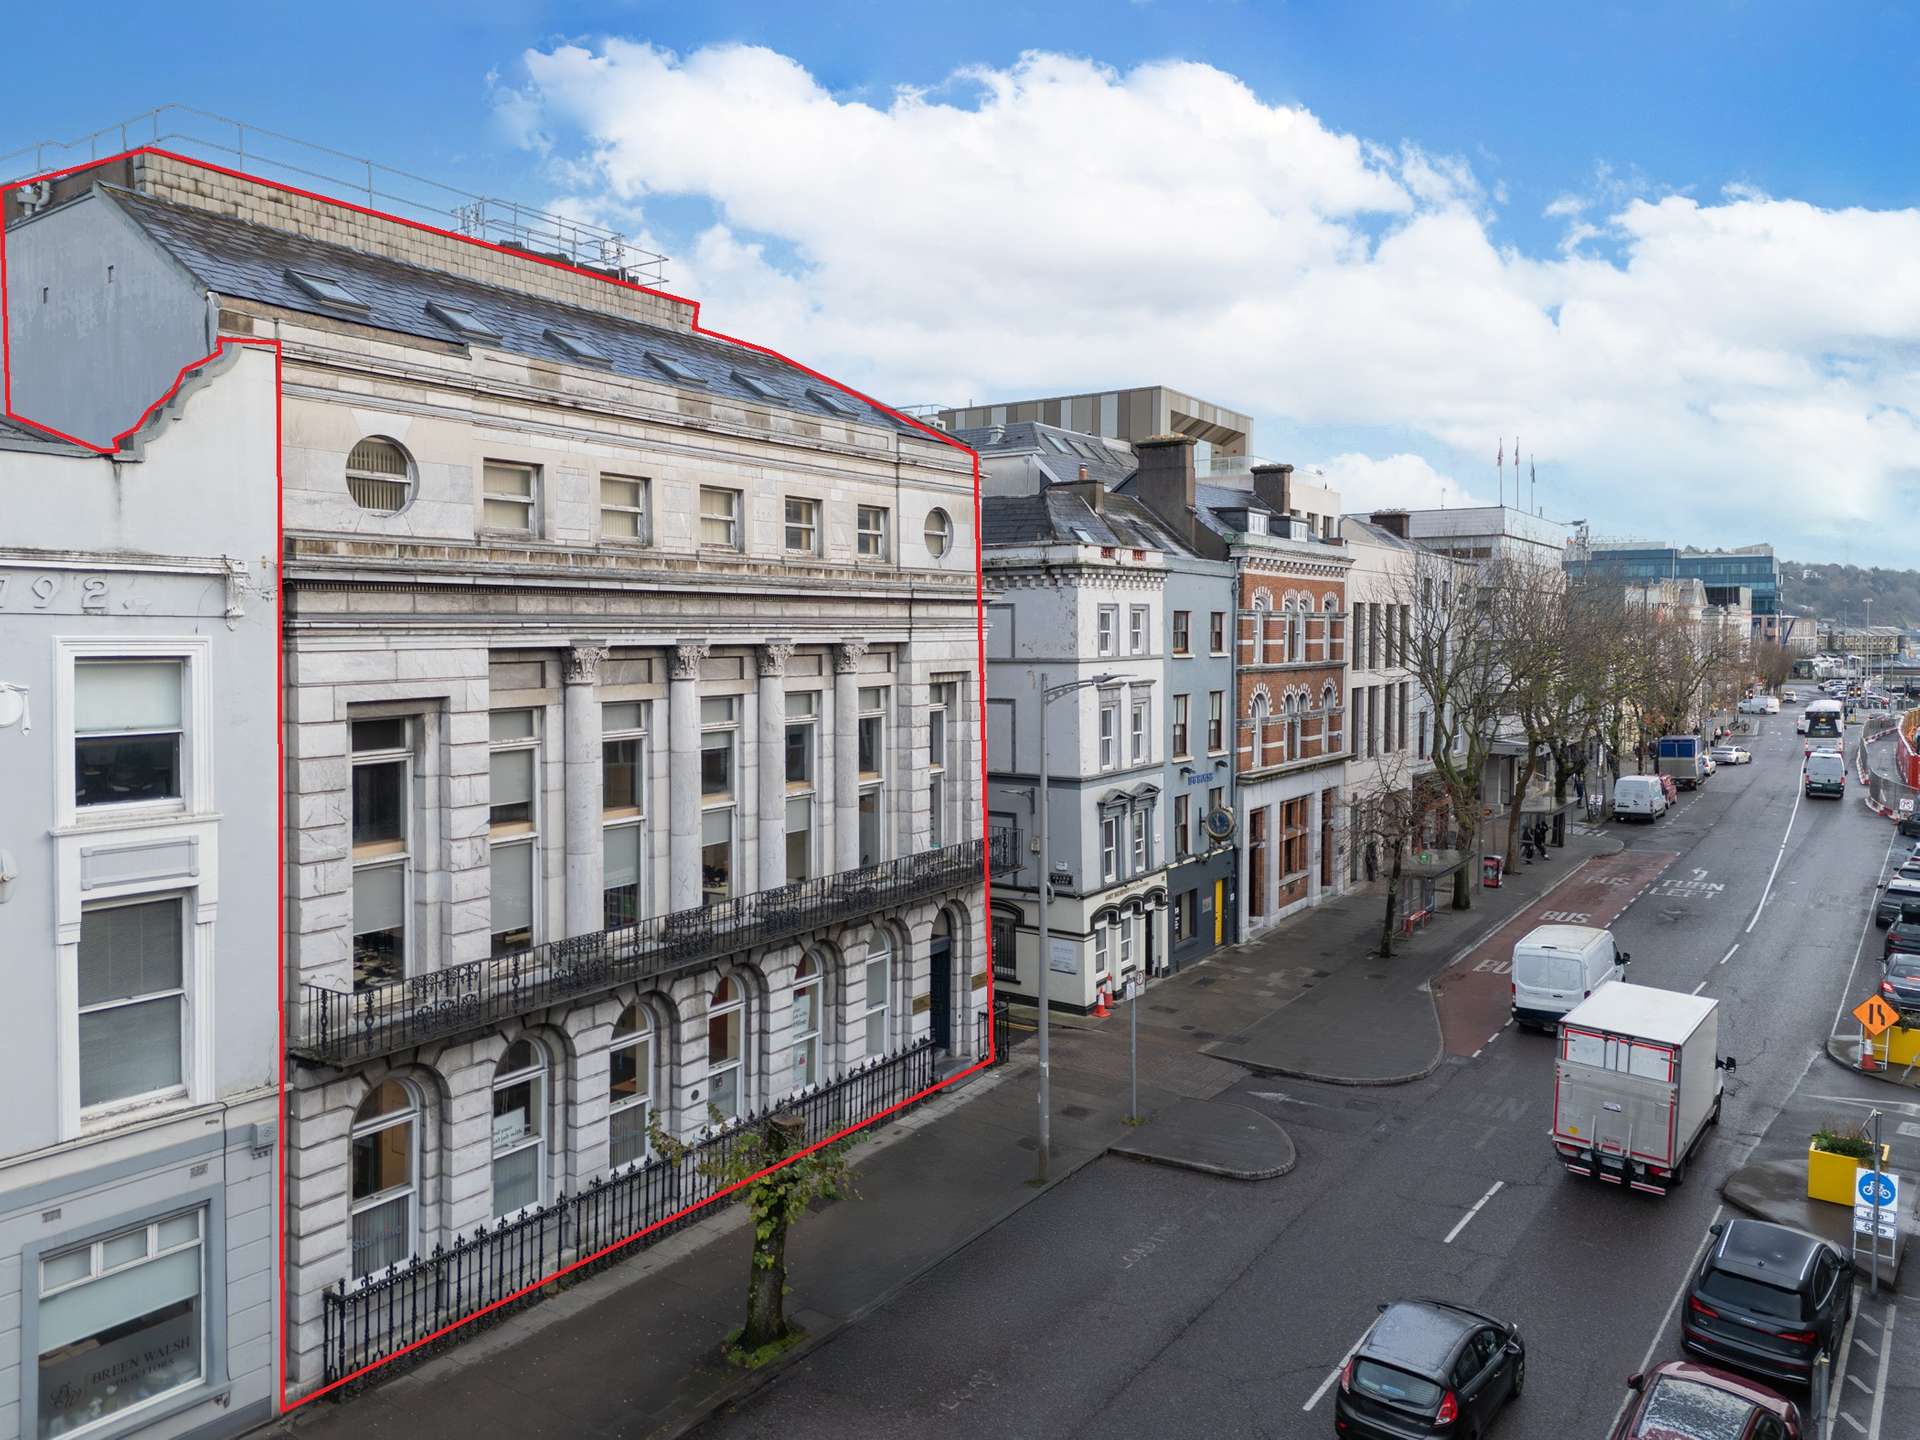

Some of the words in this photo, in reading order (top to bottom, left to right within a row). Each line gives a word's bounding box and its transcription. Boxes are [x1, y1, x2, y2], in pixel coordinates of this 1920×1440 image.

[1662, 880, 1725, 891] TURN
[1649, 887, 1721, 899] LEFT
[1540, 911, 1592, 923] BUS
[1472, 960, 1513, 974] BU
[92, 1357, 139, 1384] BREEN
[143, 1335, 190, 1363] WALSH
